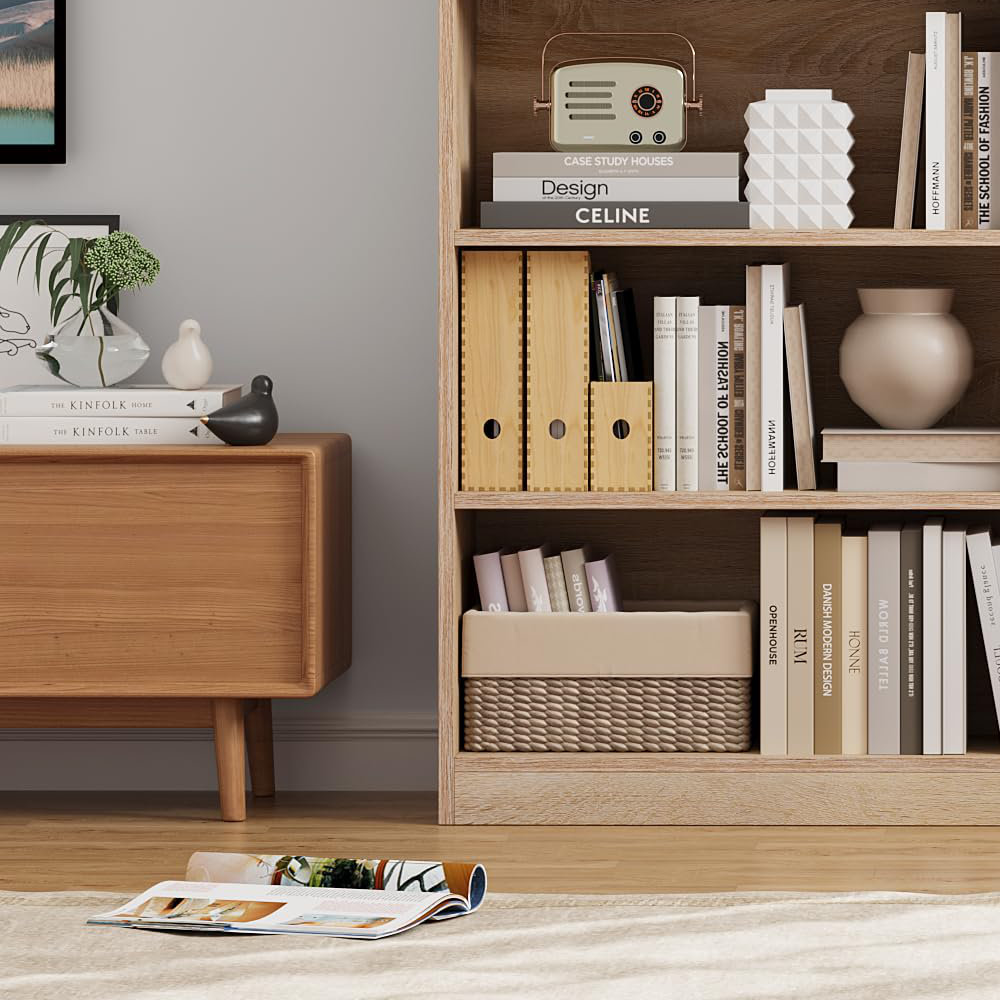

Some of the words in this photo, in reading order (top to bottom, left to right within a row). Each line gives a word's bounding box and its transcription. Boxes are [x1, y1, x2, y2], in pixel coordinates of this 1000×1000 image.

[979, 86, 990, 134] FASHION
[564, 156, 593, 167] CASE
[594, 156, 628, 167] STUDY
[631, 156, 674, 167] HOUSES
[979, 137, 990, 152] OF
[542, 180, 609, 200] Design
[931, 161, 940, 215] HOFFMANN
[979, 155, 990, 200] SCHOOL
[575, 208, 651, 224] CELINE
[979, 202, 990, 224] THE
[70, 400, 127, 410] KINFOLK
[73, 427, 129, 437] KINFOLK
[822, 583, 832, 619] DANISH
[769, 605, 778, 665] OPENHOUSE
[794, 628, 808, 664] RUM
[822, 620, 832, 661] MODERN
[849, 631, 861, 674] HONNE
[822, 662, 832, 697] DESIGN
